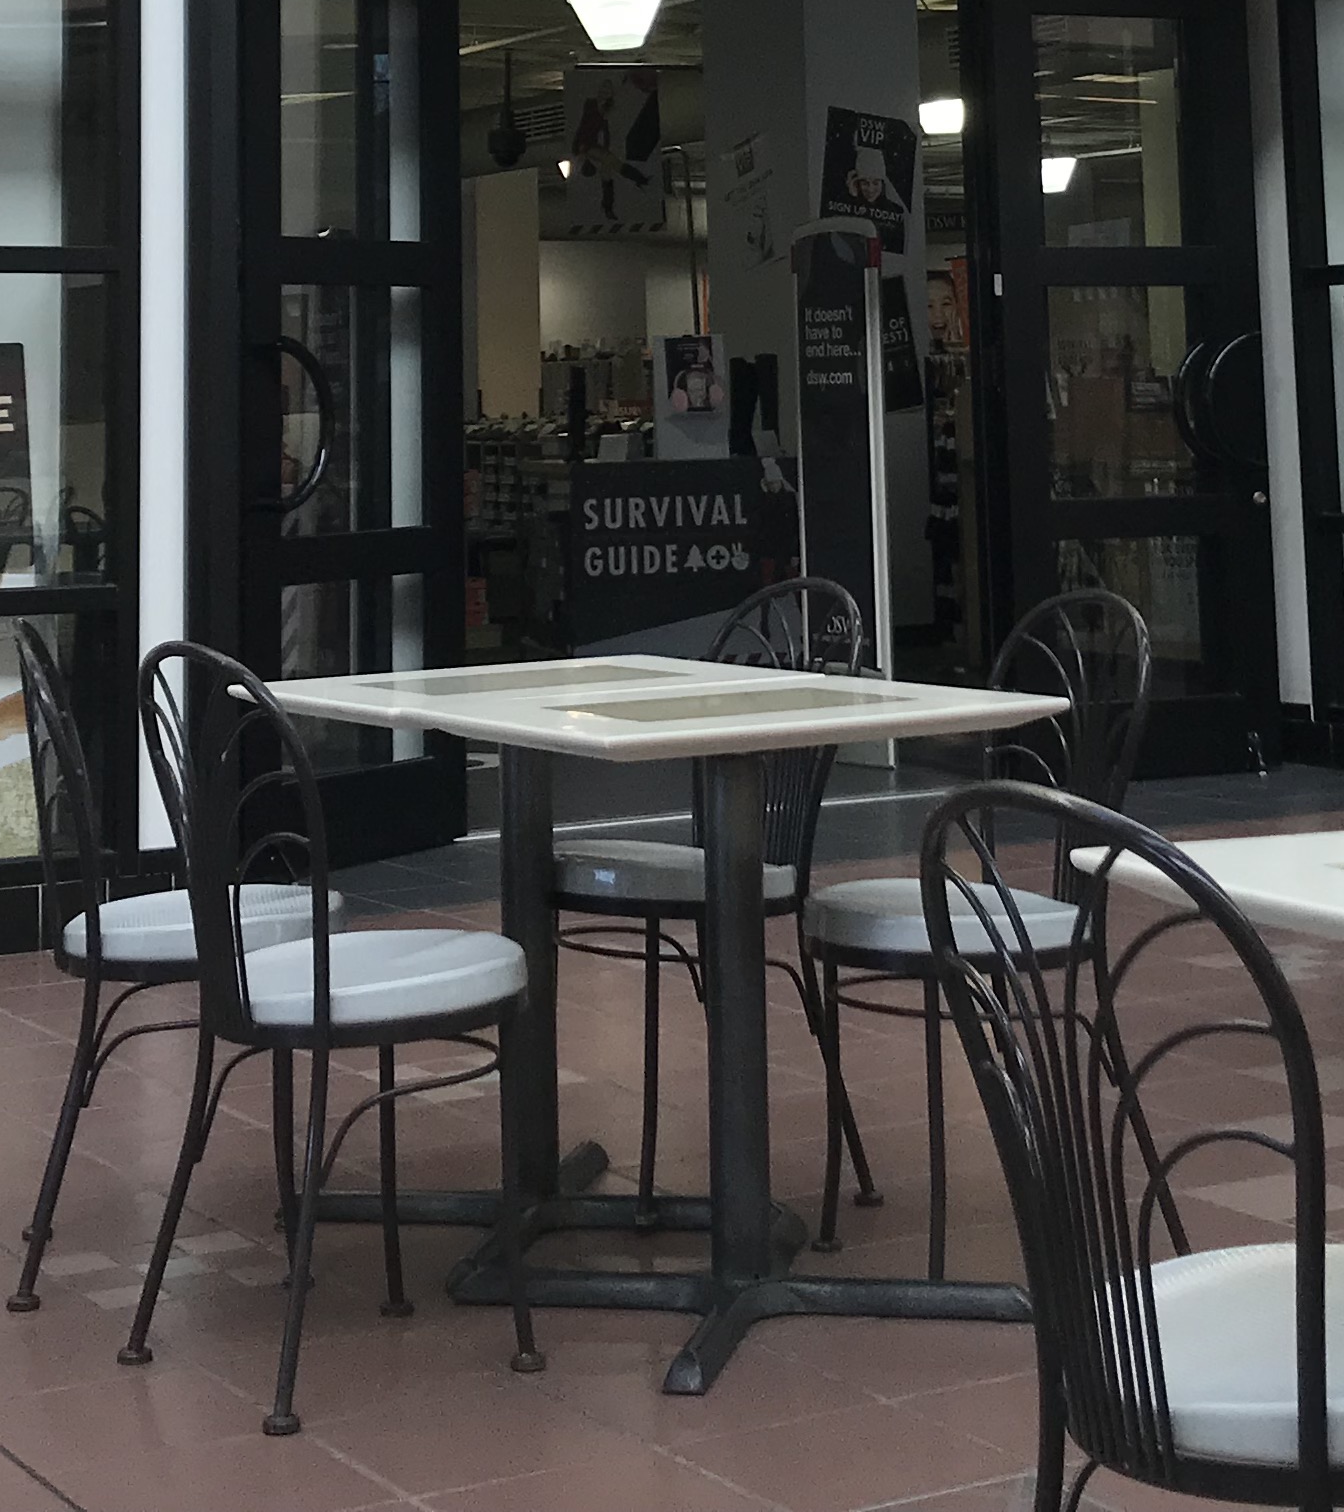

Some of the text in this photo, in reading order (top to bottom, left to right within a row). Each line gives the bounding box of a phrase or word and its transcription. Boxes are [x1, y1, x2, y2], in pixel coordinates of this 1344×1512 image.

[859, 118, 886, 132] DSW
[859, 130, 885, 145] VIP
[827, 200, 852, 214] SIGN
[853, 205, 868, 216] UP
[814, 305, 853, 323] doesn't
[805, 325, 843, 340] have to
[805, 343, 825, 358] end
[806, 370, 853, 385] dsw.com
[583, 493, 748, 530] SURVIVAL
[584, 544, 678, 576] GUIDE
